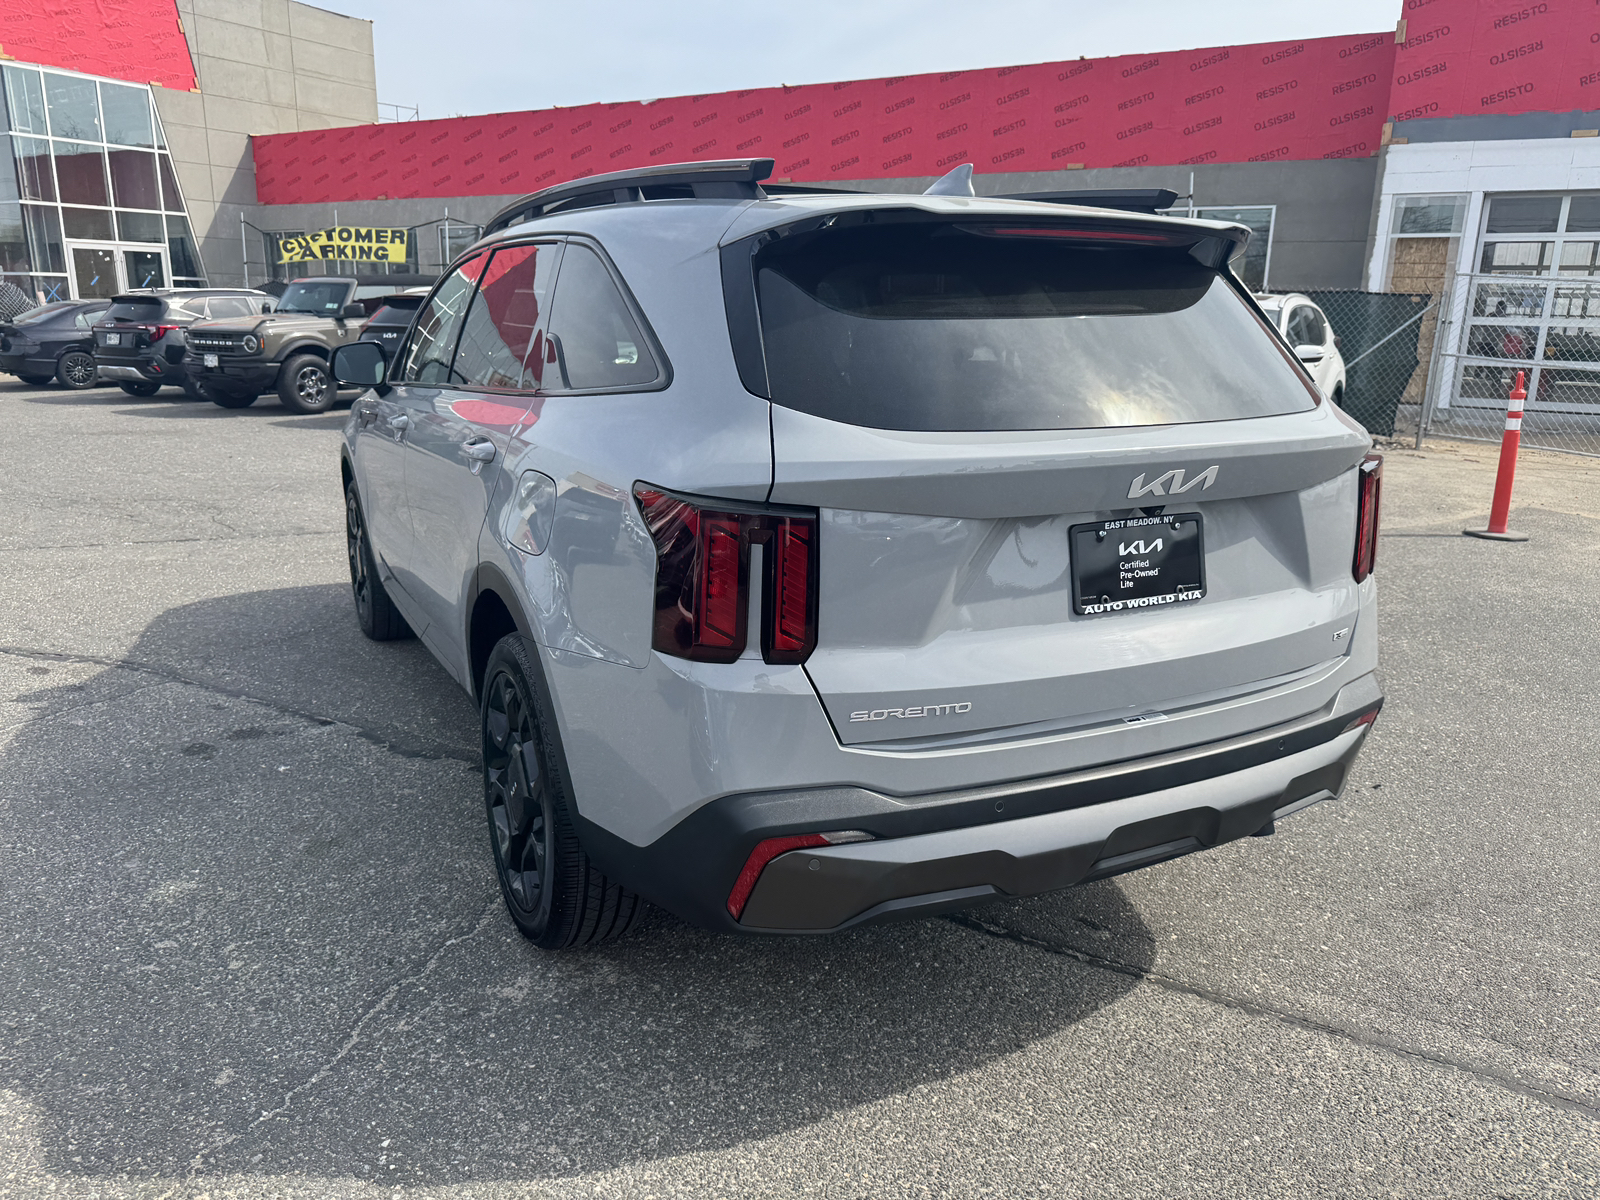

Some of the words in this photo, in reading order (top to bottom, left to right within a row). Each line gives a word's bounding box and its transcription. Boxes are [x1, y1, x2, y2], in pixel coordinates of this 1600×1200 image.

[1494, 4, 1548, 29] RESISTO
[1262, 44, 1304, 65] RESISTO
[1339, 37, 1384, 58] RESISTO
[1490, 41, 1543, 65] RESISTO
[1122, 59, 1159, 78] RESISTO
[1190, 51, 1230, 72] RESISTO
[1058, 63, 1093, 81] RESISTO
[1398, 62, 1447, 85] RESISTO
[1256, 80, 1298, 100] RESISTO
[1332, 74, 1376, 95] RESISTO
[940, 93, 970, 110] RESISTO
[997, 88, 1030, 106] RESISTO
[1118, 92, 1154, 110] RESISTO
[1185, 86, 1224, 106] RESISTO
[1481, 83, 1534, 106] RESISTO
[785, 105, 811, 120] RESISTO
[834, 101, 861, 118] RESISTO
[885, 97, 915, 114] RESISTO
[1054, 95, 1089, 113] RESISTO
[738, 108, 763, 123] RESISTO
[1254, 112, 1295, 131] RESISTO
[1330, 106, 1374, 126] RESISTO
[883, 127, 912, 143] RESISTO
[937, 123, 968, 140] RESISTO
[993, 119, 1026, 137] RESISTO
[1117, 122, 1153, 140] RESISTO
[1183, 116, 1222, 136] RESISTO
[736, 136, 762, 150] RESISTO
[783, 133, 810, 148] RESISTO
[832, 130, 859, 146] RESISTO
[936, 151, 968, 167] RESISTO
[992, 148, 1025, 164] RESISTO
[1052, 142, 1086, 159] RESISTO
[831, 156, 860, 172] RESISTO
[883, 153, 912, 170] RESISTO
[1127, 465, 1219, 499] KIA
[1104, 521, 1125, 530] EAST
[1163, 515, 1175, 523] NY
[1119, 538, 1164, 556] KIA
[1119, 559, 1150, 570] Certified
[1120, 580, 1134, 589] Lite
[1084, 601, 1123, 615] AUTO
[1127, 594, 1175, 609] WORLD
[1178, 590, 1202, 601] KIA
[850, 701, 972, 723] SORENTO
